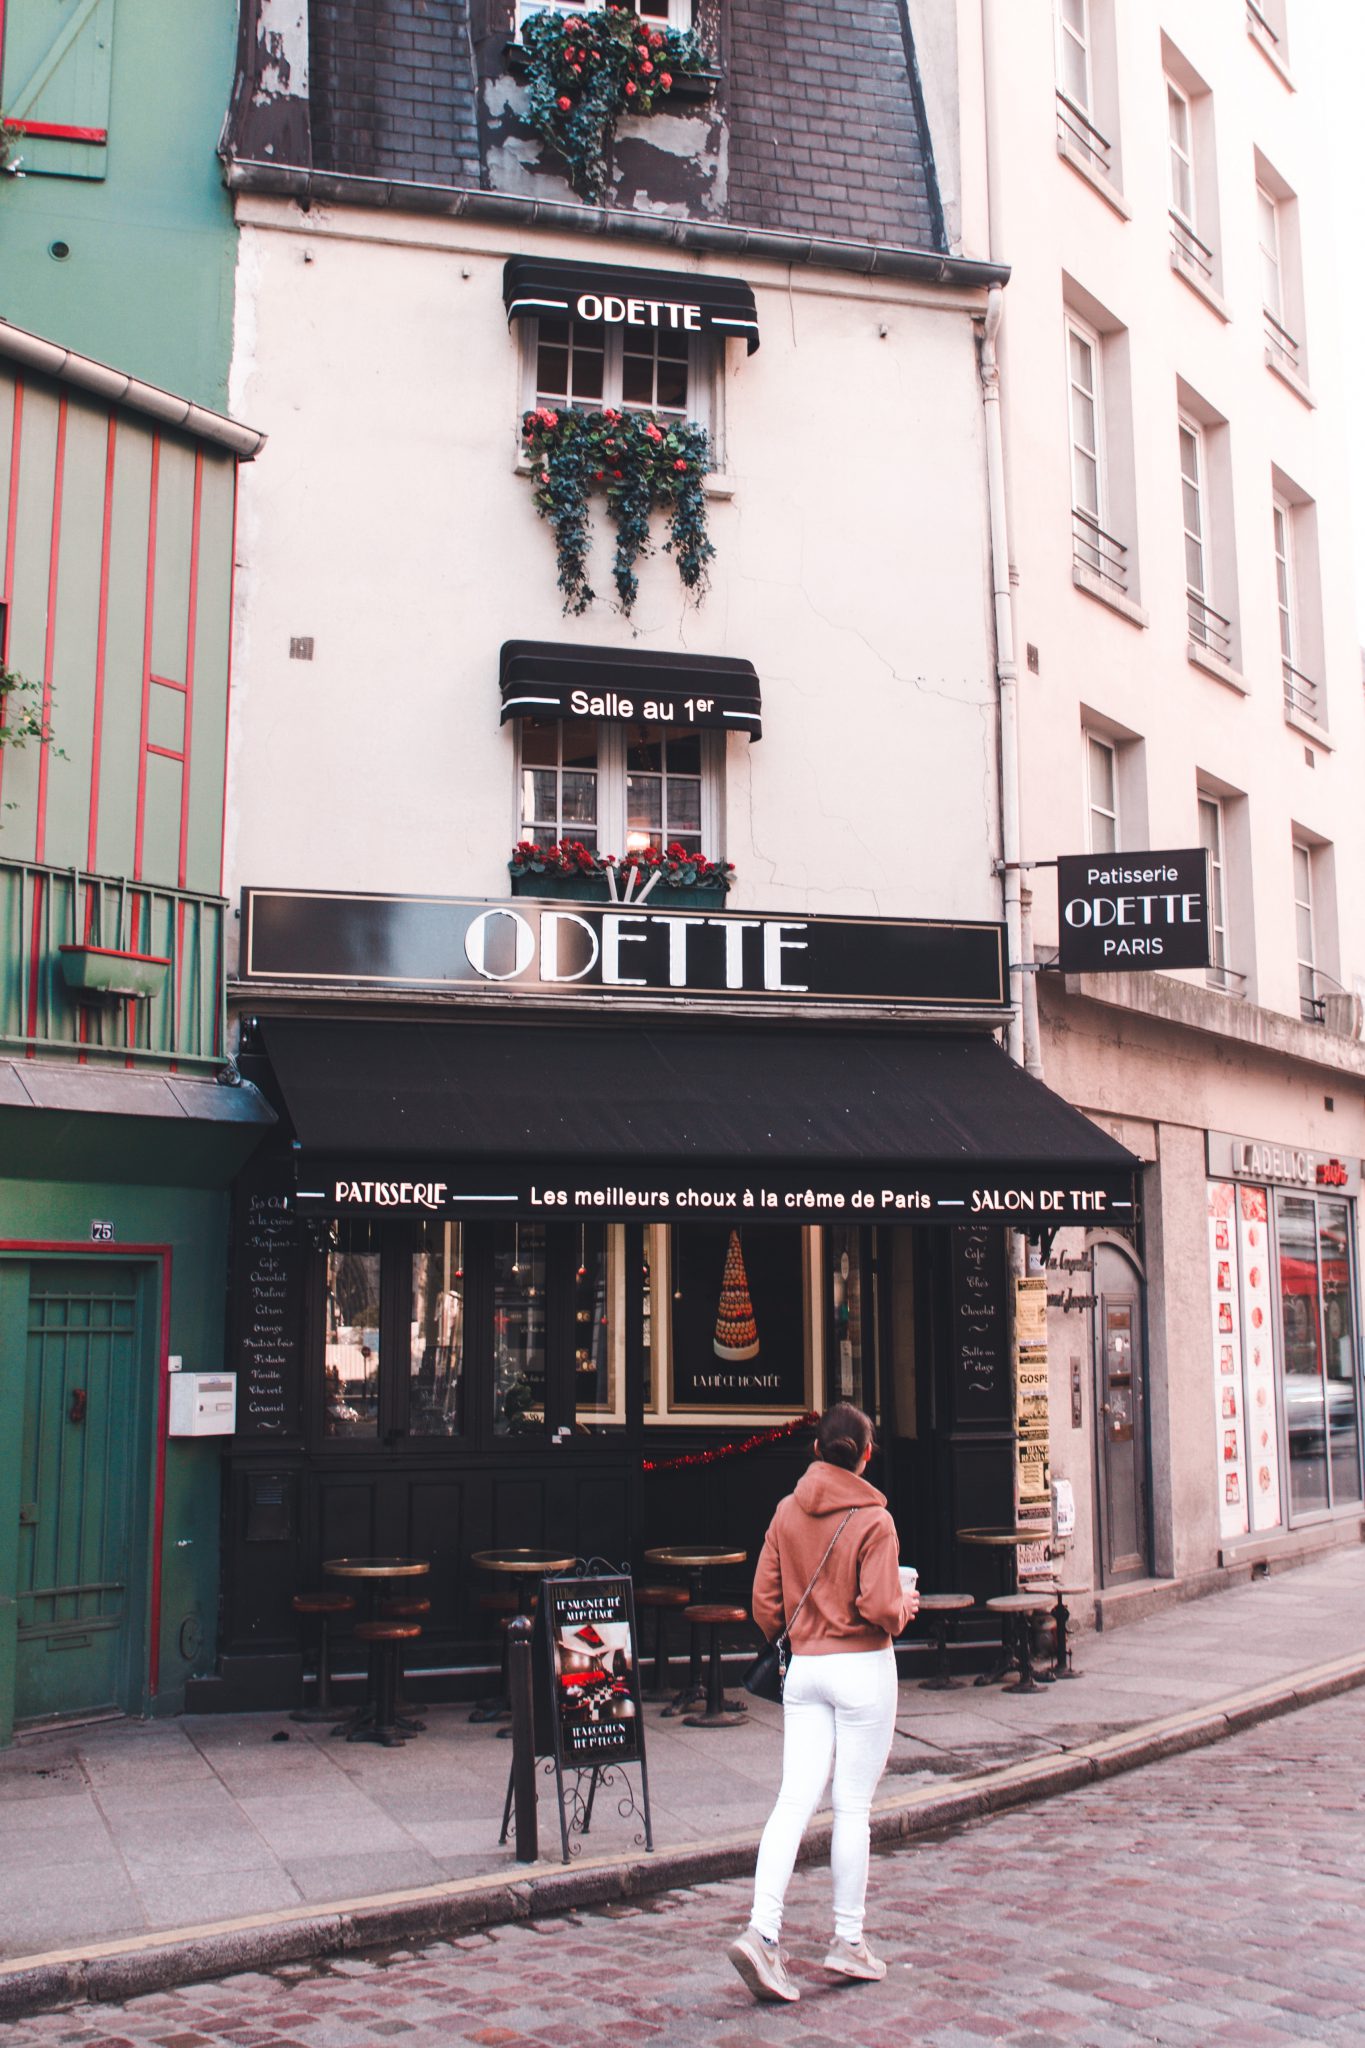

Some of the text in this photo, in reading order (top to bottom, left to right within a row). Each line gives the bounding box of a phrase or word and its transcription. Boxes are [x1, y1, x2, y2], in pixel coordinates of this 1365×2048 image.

[577, 294, 701, 330] ODETTE
[571, 690, 714, 722] Salle au 1er
[1087, 865, 1178, 885] Patisserie
[1065, 893, 1201, 928] ODETTE
[464, 908, 809, 992] ODETTE
[1103, 938, 1164, 956] PARIS
[335, 1181, 447, 1209] PATISSERIE
[531, 1186, 568, 1205] Les
[574, 1187, 670, 1206] meilleurs
[675, 1188, 737, 1207] choux
[743, 1189, 754, 1207] à
[760, 1189, 778, 1207] la
[851, 1190, 875, 1208] de
[881, 1190, 931, 1209] Paris
[970, 1190, 1107, 1212] SALON DE THE
[94, 1224, 112, 1240] 75
[250, 1271, 287, 1282] Chocolat
[960, 1304, 995, 1316] Chocolat
[961, 1345, 984, 1357] Salle
[249, 1401, 285, 1413] Caramel
